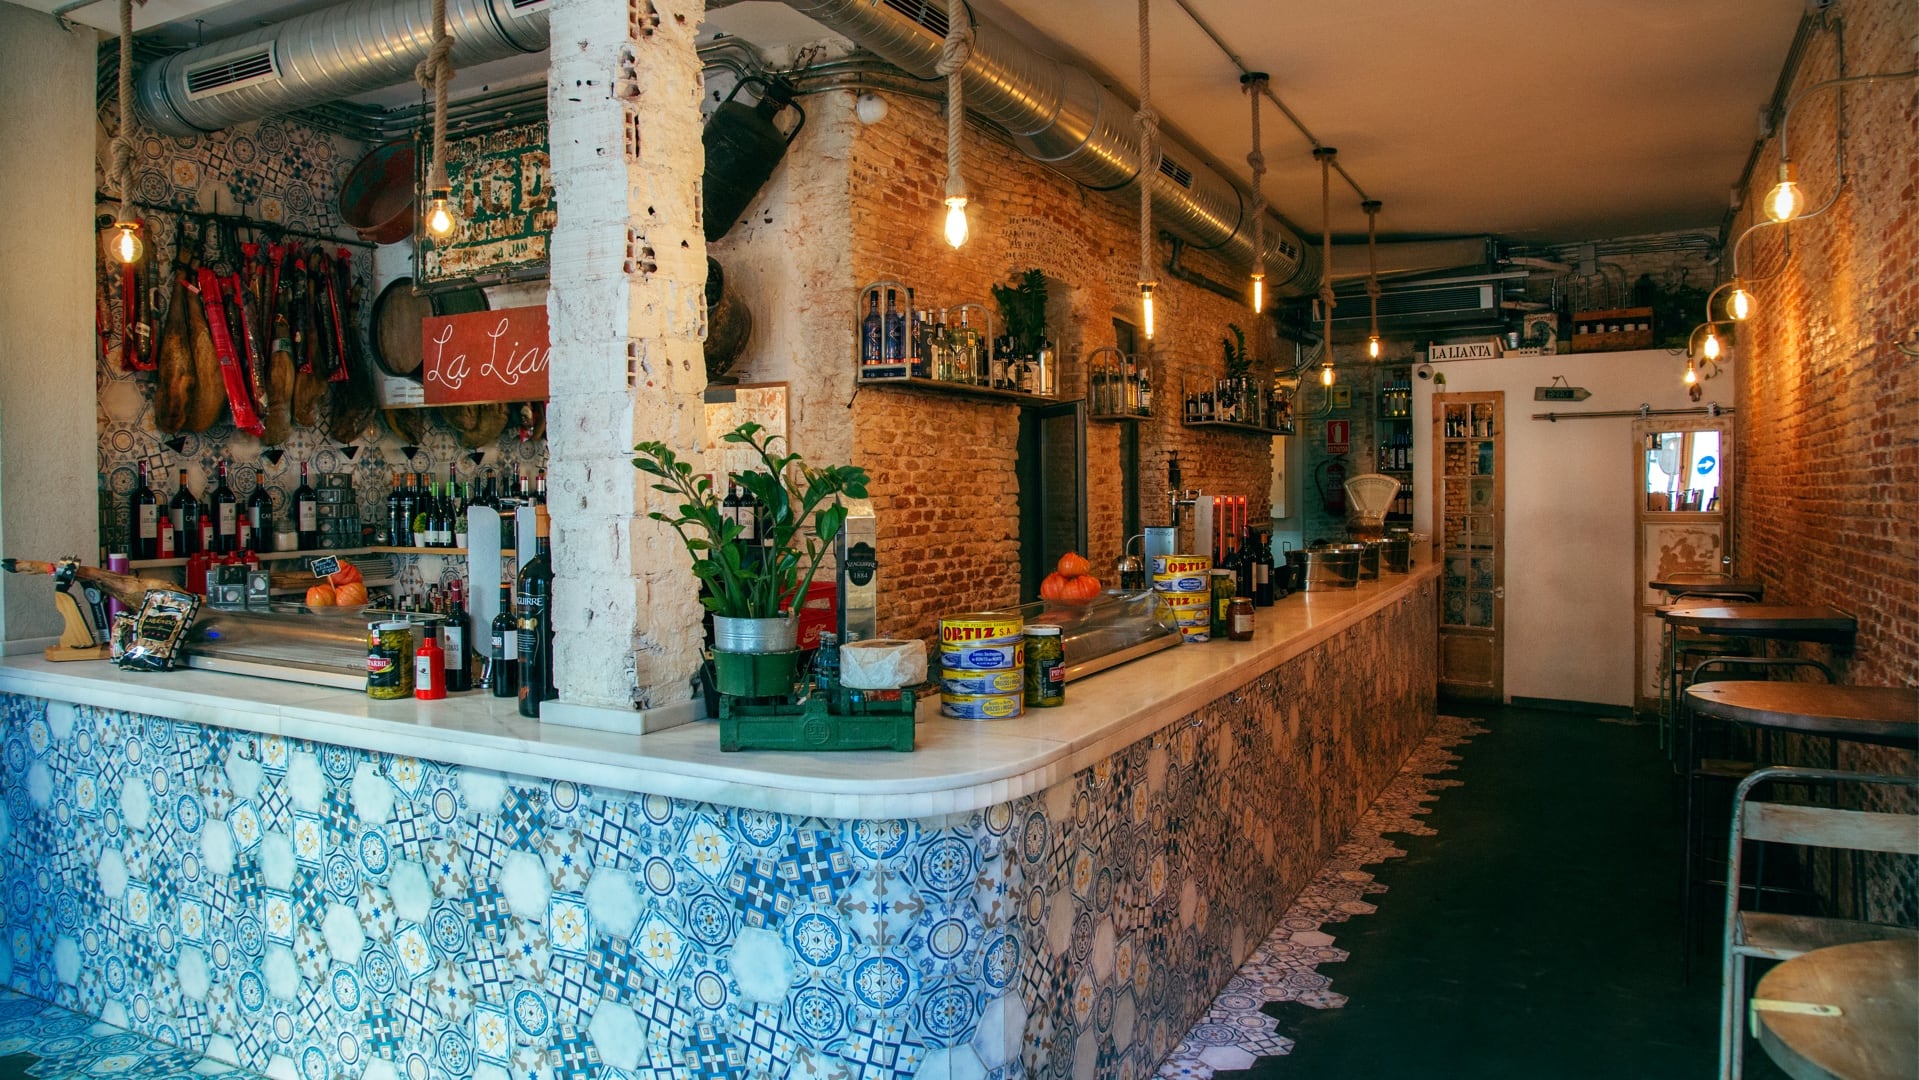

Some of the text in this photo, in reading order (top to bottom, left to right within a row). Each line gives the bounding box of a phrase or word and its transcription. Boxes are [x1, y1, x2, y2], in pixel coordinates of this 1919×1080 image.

[427, 324, 471, 390] La
[1432, 344, 1492, 360] LA LIANTA
[1168, 562, 1206, 573] ORTIZ
[1167, 597, 1189, 606] TIZ
[943, 626, 995, 641] ORTIZ
